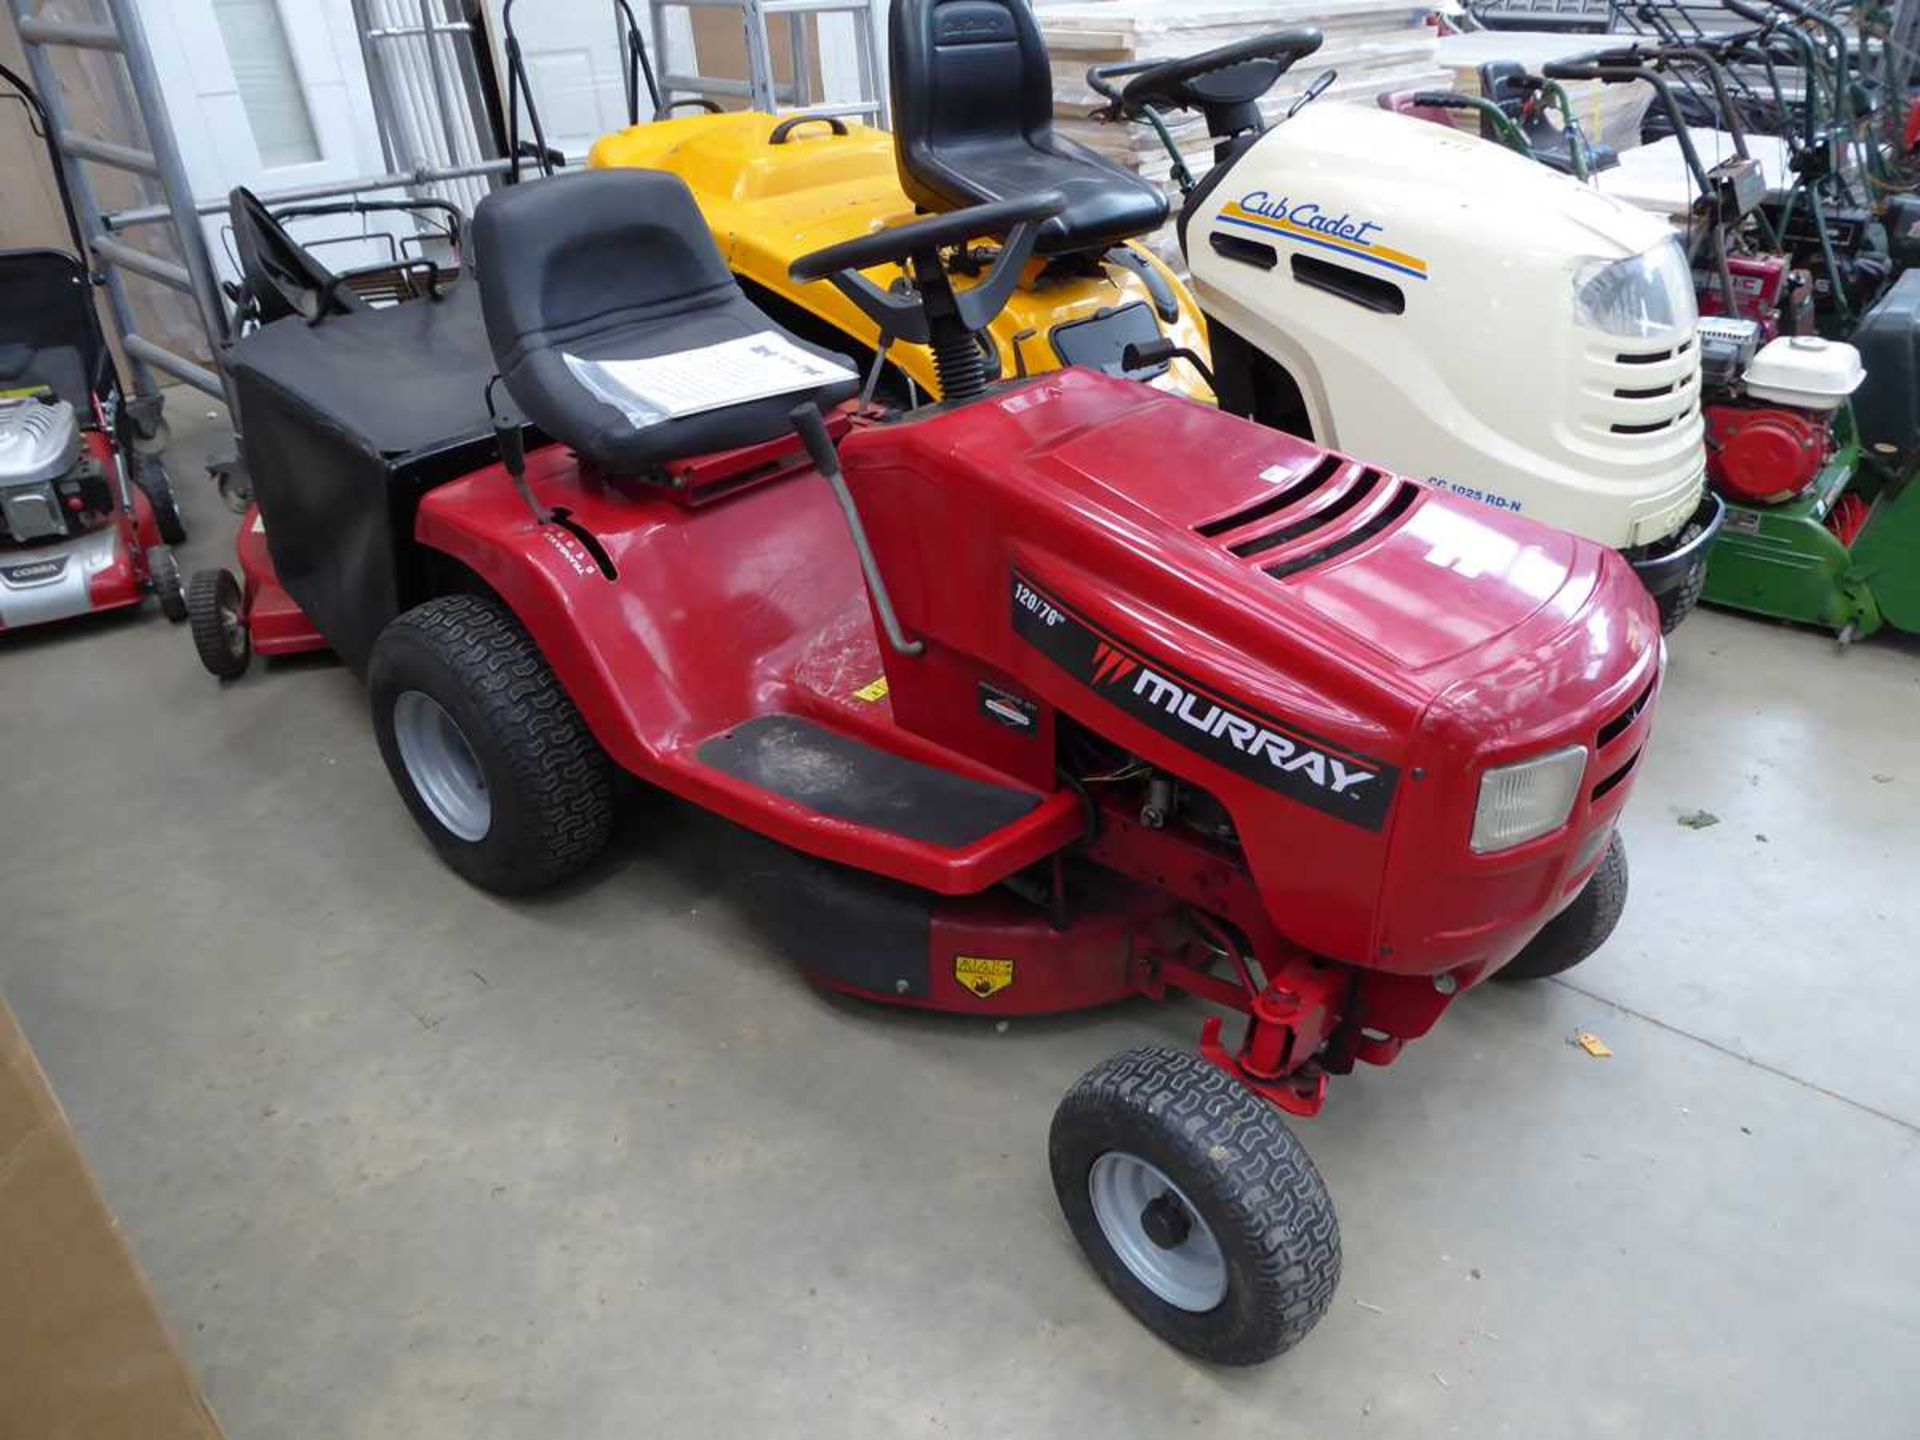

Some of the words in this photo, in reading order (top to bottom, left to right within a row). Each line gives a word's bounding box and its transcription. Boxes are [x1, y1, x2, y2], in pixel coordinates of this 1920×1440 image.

[1239, 190, 1289, 220] Cub
[1289, 203, 1384, 246] Cadet
[1451, 483, 1483, 501] 1025
[1485, 493, 1523, 513] RD-N
[1132, 668, 1376, 793] MURRAY
